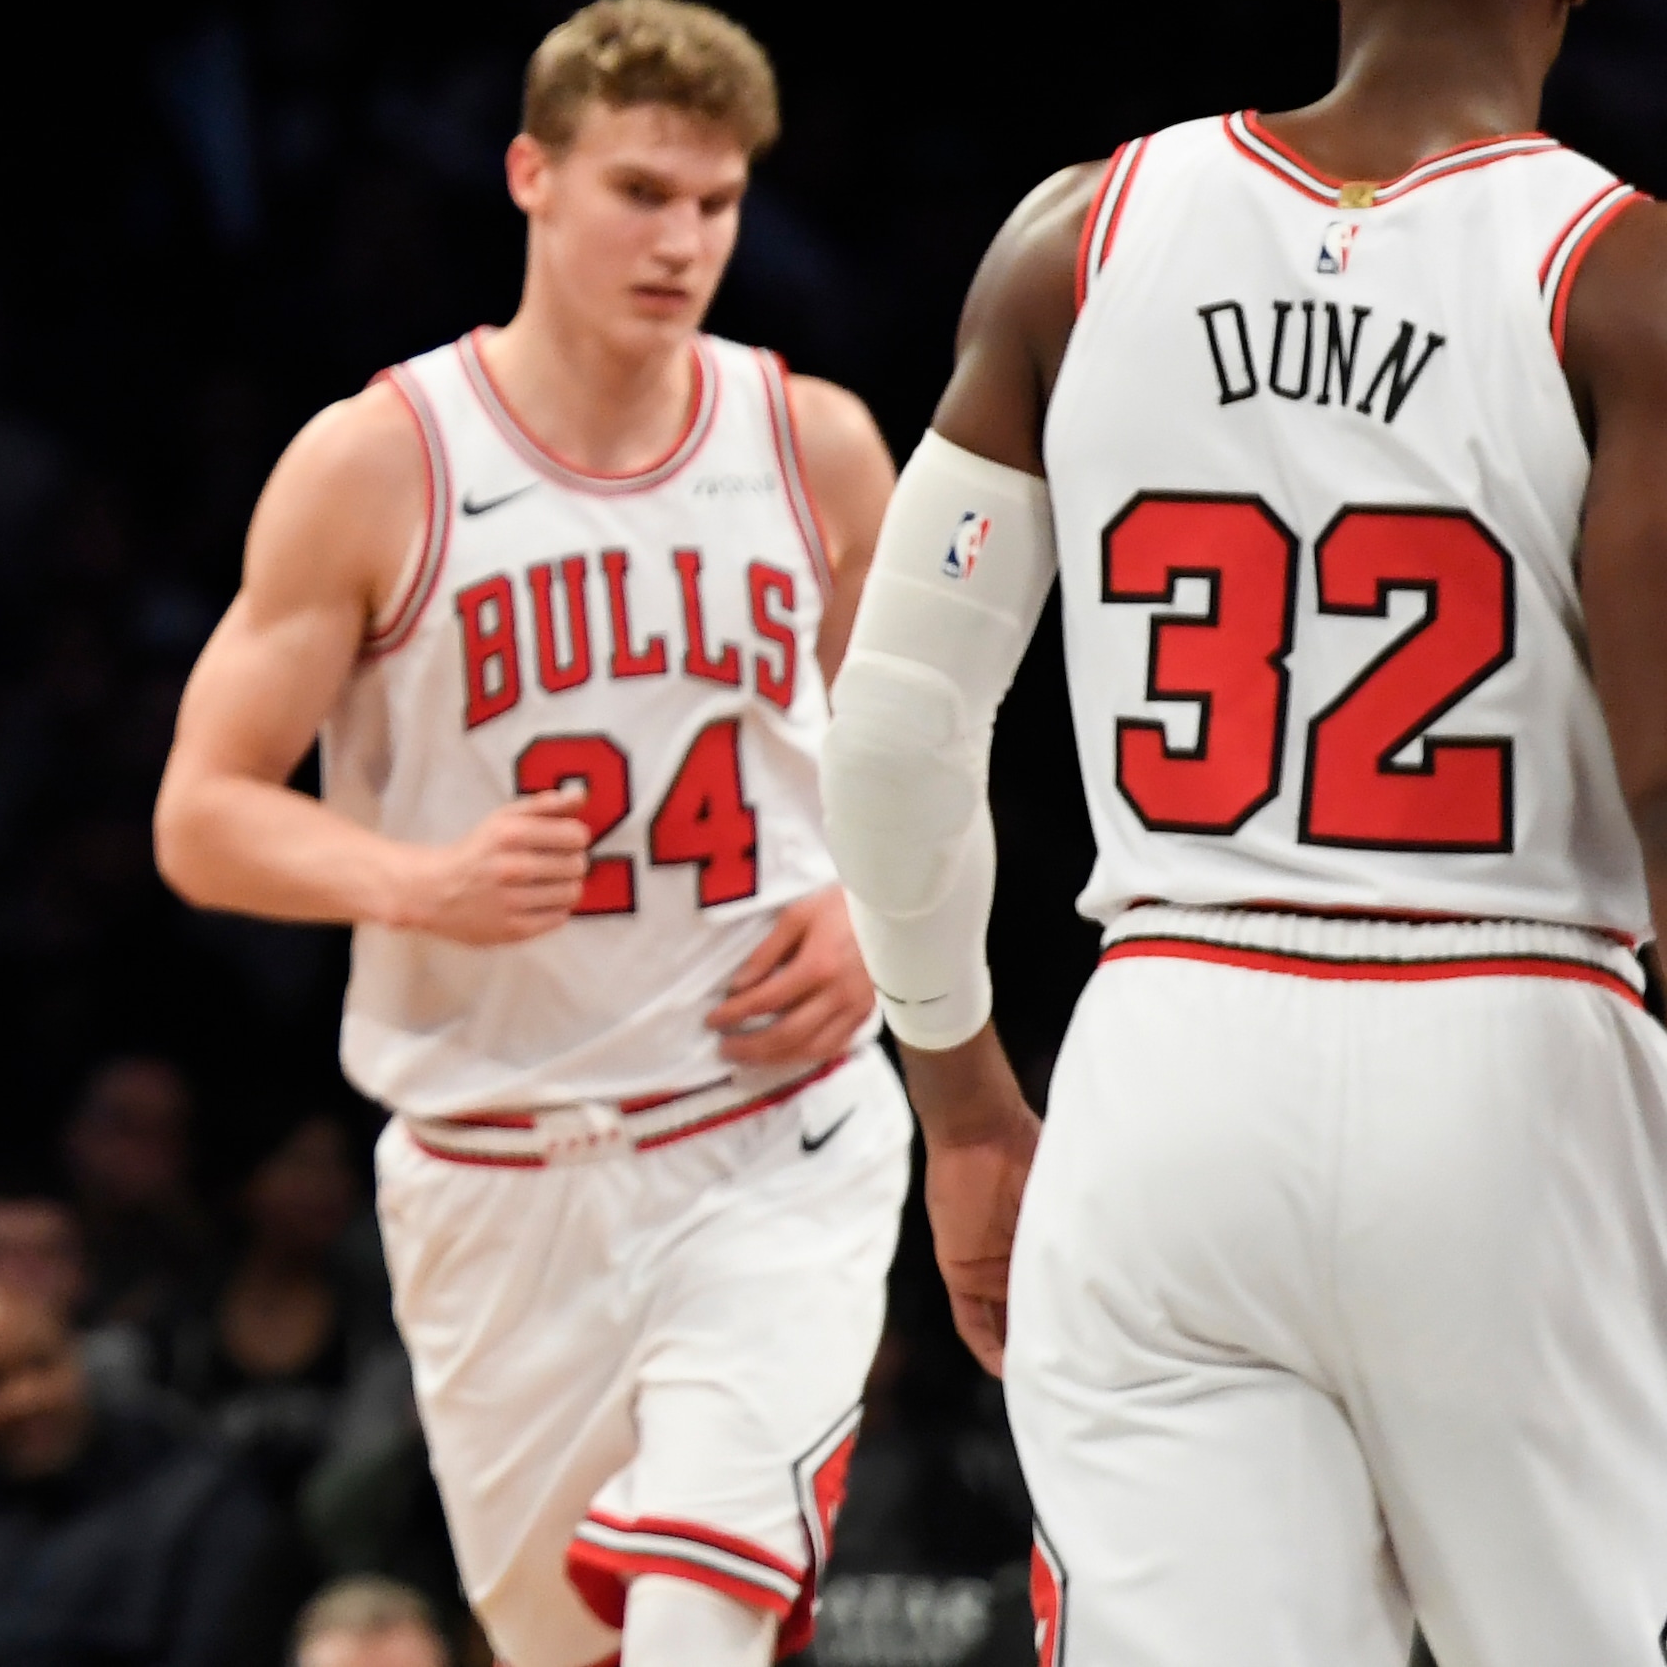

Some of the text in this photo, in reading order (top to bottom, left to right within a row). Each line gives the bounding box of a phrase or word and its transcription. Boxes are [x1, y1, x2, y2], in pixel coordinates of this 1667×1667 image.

[1198, 299, 1446, 424] DUNN
[456, 548, 797, 731] BULLS
[1100, 489, 1516, 854] 32
[516, 716, 759, 917] 24
